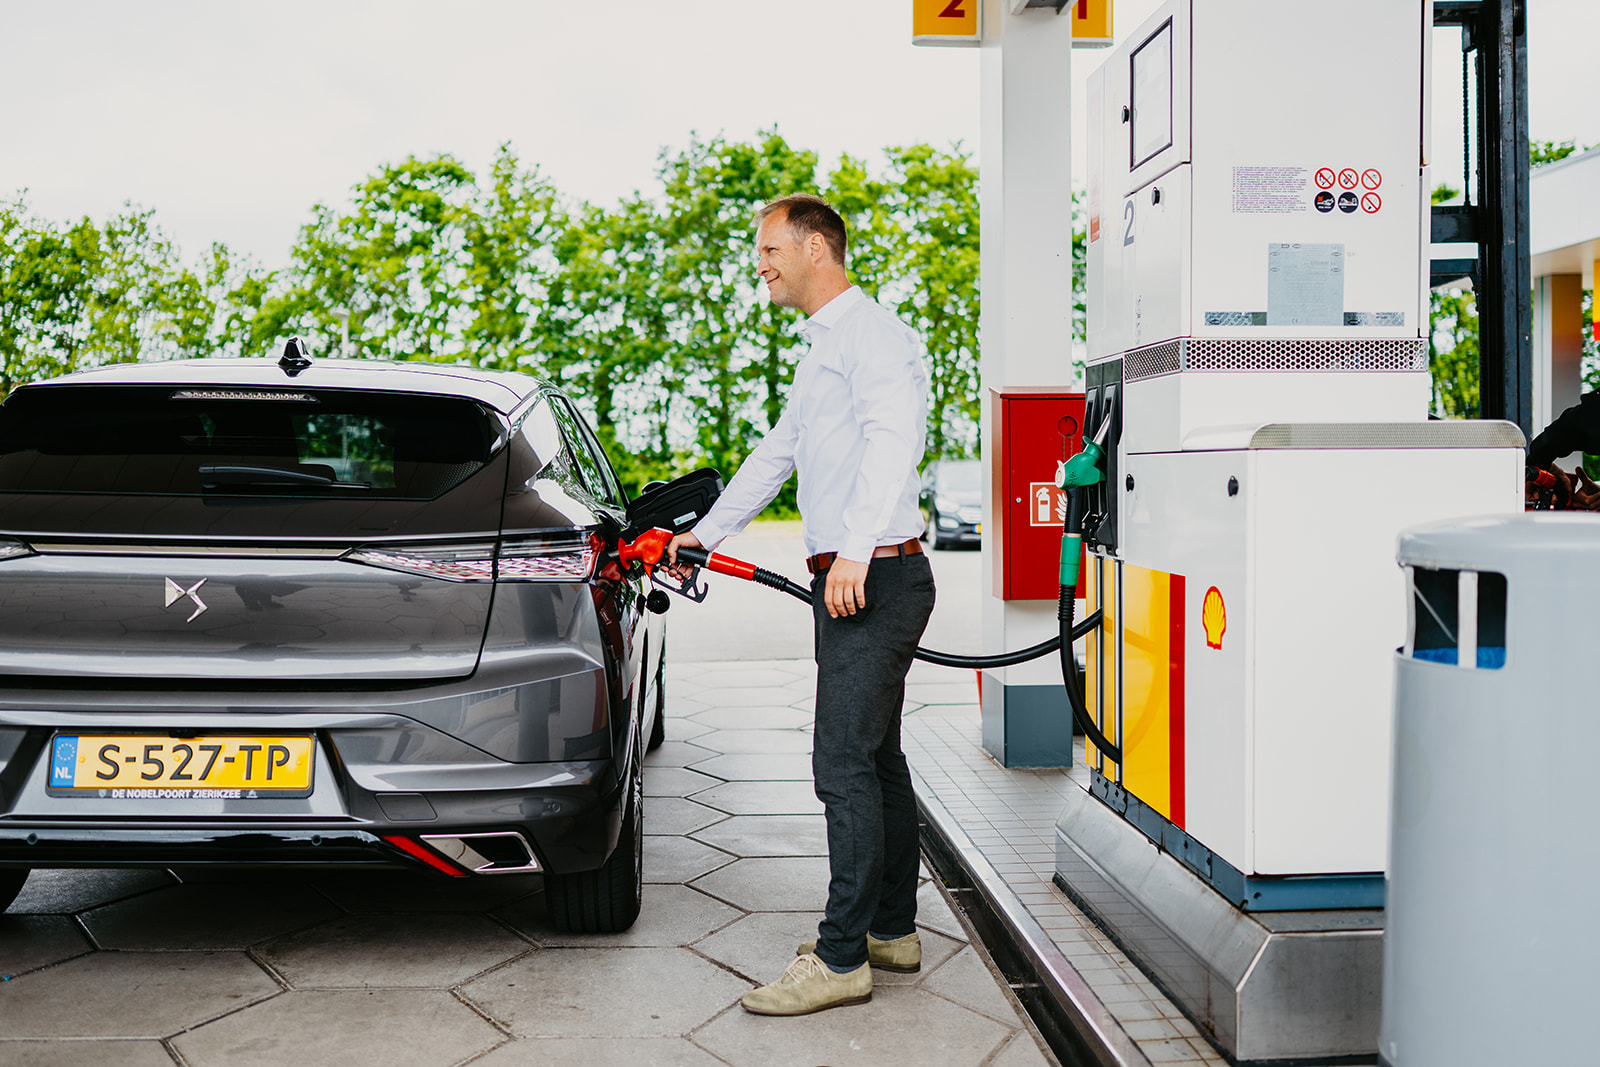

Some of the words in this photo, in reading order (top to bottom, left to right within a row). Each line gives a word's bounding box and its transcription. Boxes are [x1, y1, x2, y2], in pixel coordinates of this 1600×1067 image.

[1123, 199, 1135, 247] 2
[54, 766, 73, 780] NL
[95, 743, 290, 781] S-527-TP
[112, 788, 123, 799] DE
[126, 788, 190, 799] NOBELPOORT
[192, 788, 241, 799] ZIERIKZEE
